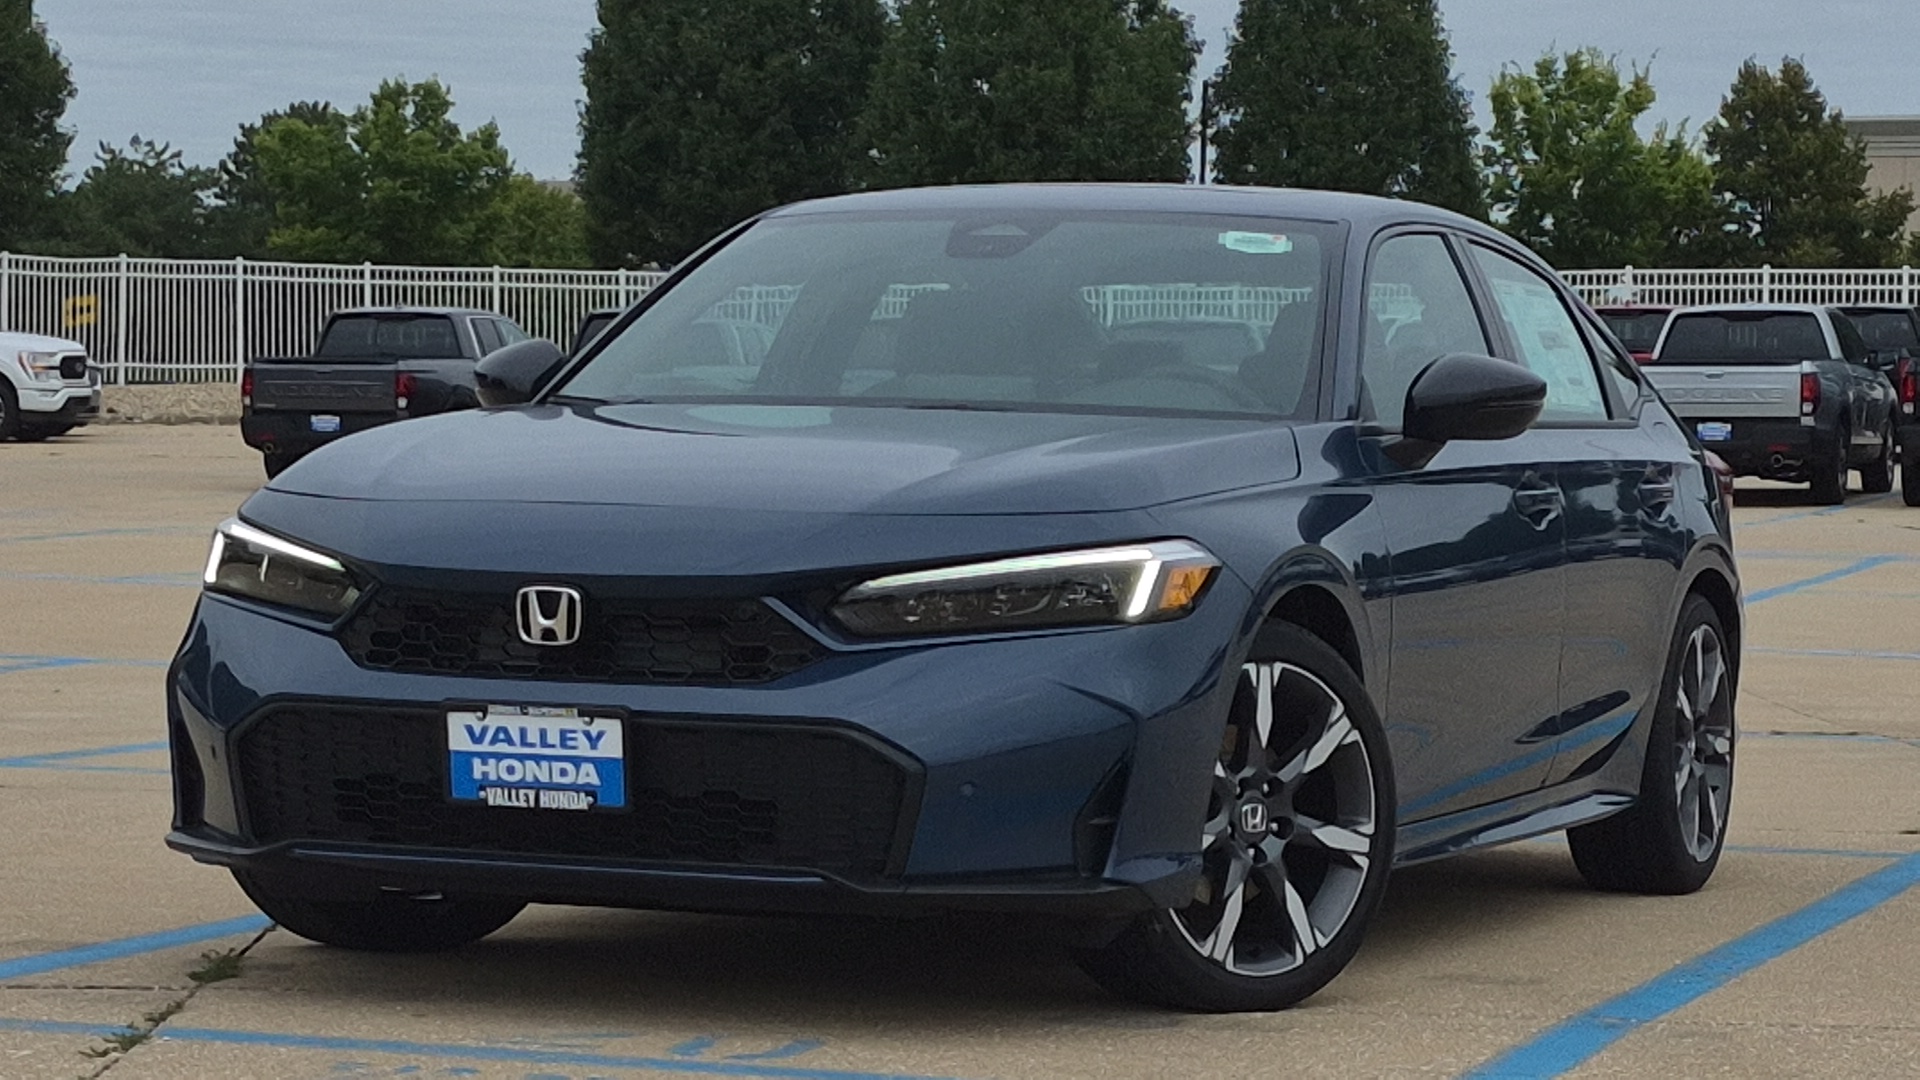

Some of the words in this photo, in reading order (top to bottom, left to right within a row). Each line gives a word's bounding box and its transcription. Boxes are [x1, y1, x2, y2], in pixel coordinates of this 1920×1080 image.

[463, 724, 606, 750] VALLEY
[471, 757, 601, 786] HONDA
[486, 787, 536, 808] VALLEY
[539, 790, 589, 811] HONDA
